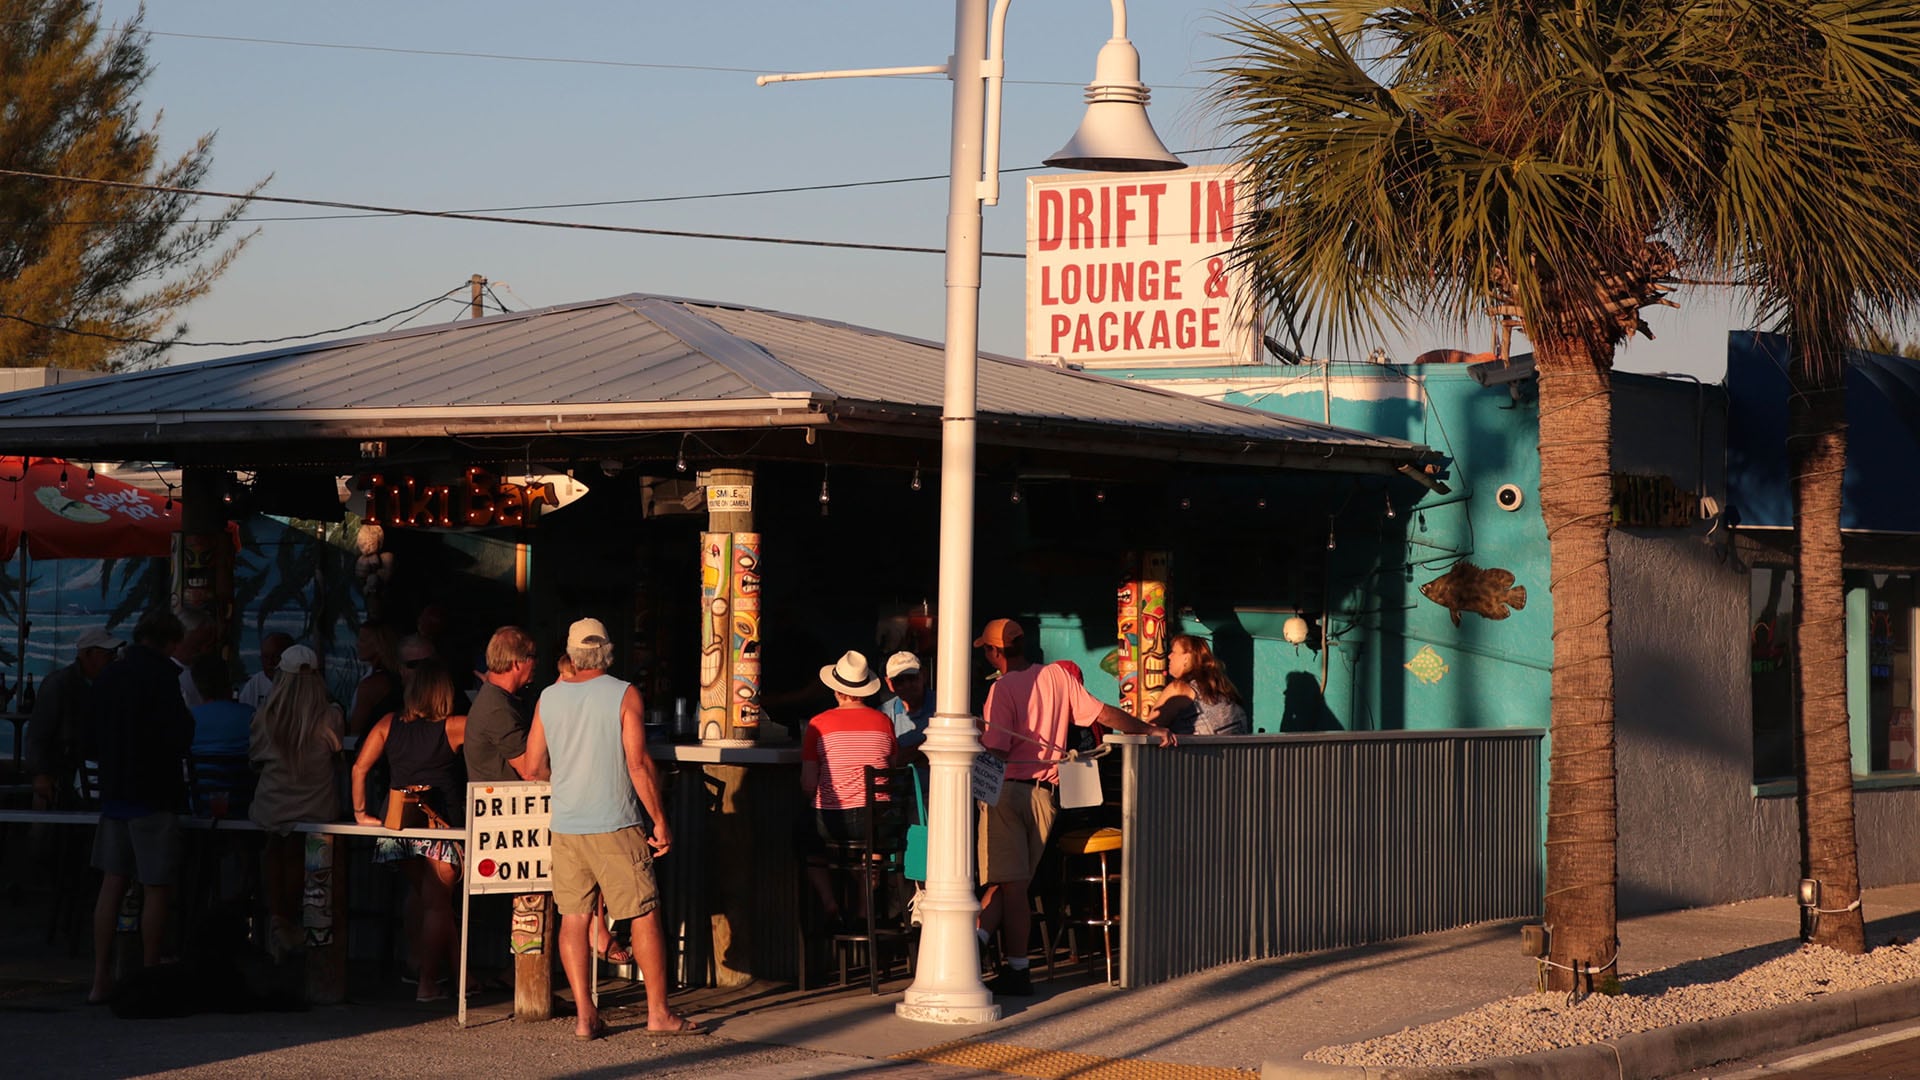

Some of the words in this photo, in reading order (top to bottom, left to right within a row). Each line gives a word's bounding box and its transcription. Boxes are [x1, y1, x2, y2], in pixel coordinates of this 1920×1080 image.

[1039, 183, 1167, 251] DRIFT
[1190, 179, 1235, 244] IN
[1041, 260, 1182, 306] LOUNGE
[1203, 257, 1229, 299] &
[1051, 307, 1220, 353] PACKAGE
[117, 504, 159, 521] TOP
[464, 466, 560, 529] Bar
[475, 795, 552, 816] DRIFT
[480, 828, 552, 850] PARKI
[499, 860, 553, 880] ONL
